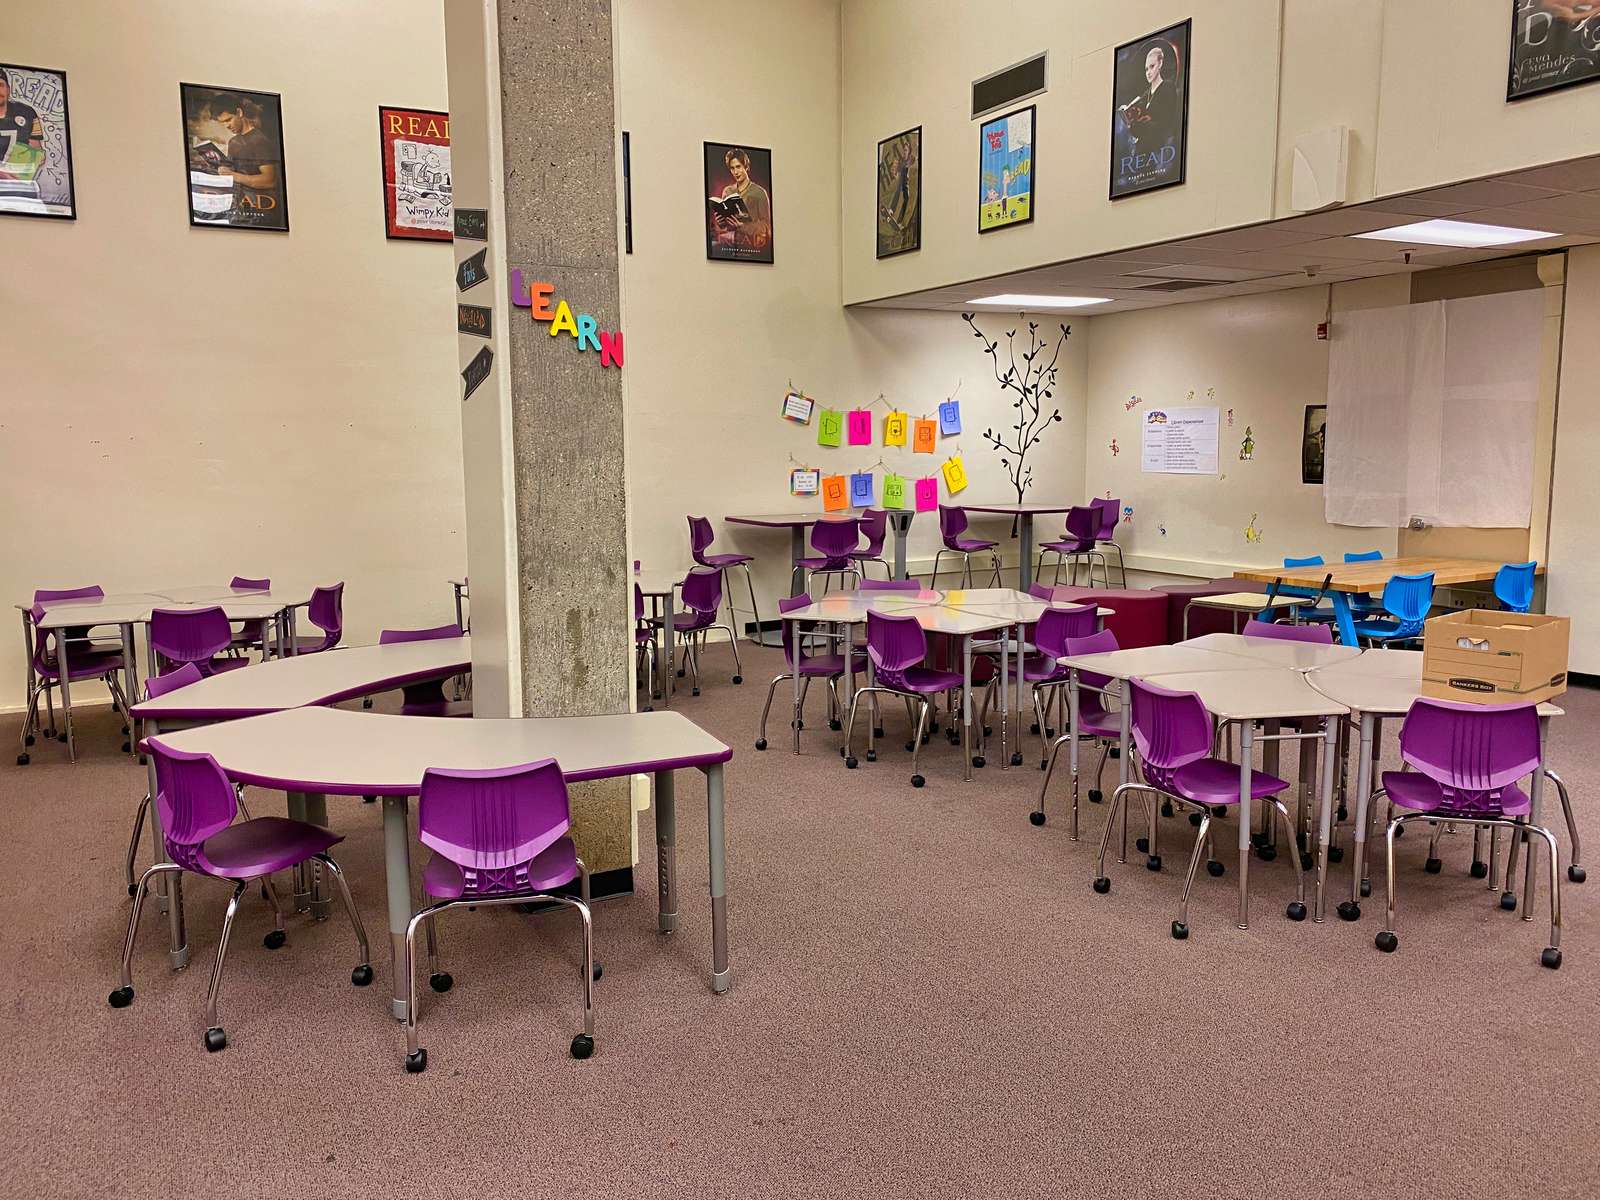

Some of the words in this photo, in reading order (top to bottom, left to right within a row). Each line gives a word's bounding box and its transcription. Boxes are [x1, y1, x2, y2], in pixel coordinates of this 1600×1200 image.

[9, 71, 64, 113] READ
[1120, 146, 1176, 175] READ
[406, 206, 434, 219] Wimpy
[436, 206, 450, 218] Kid
[511, 267, 624, 368] LEARN
[1452, 681, 1479, 689] BANKERS
